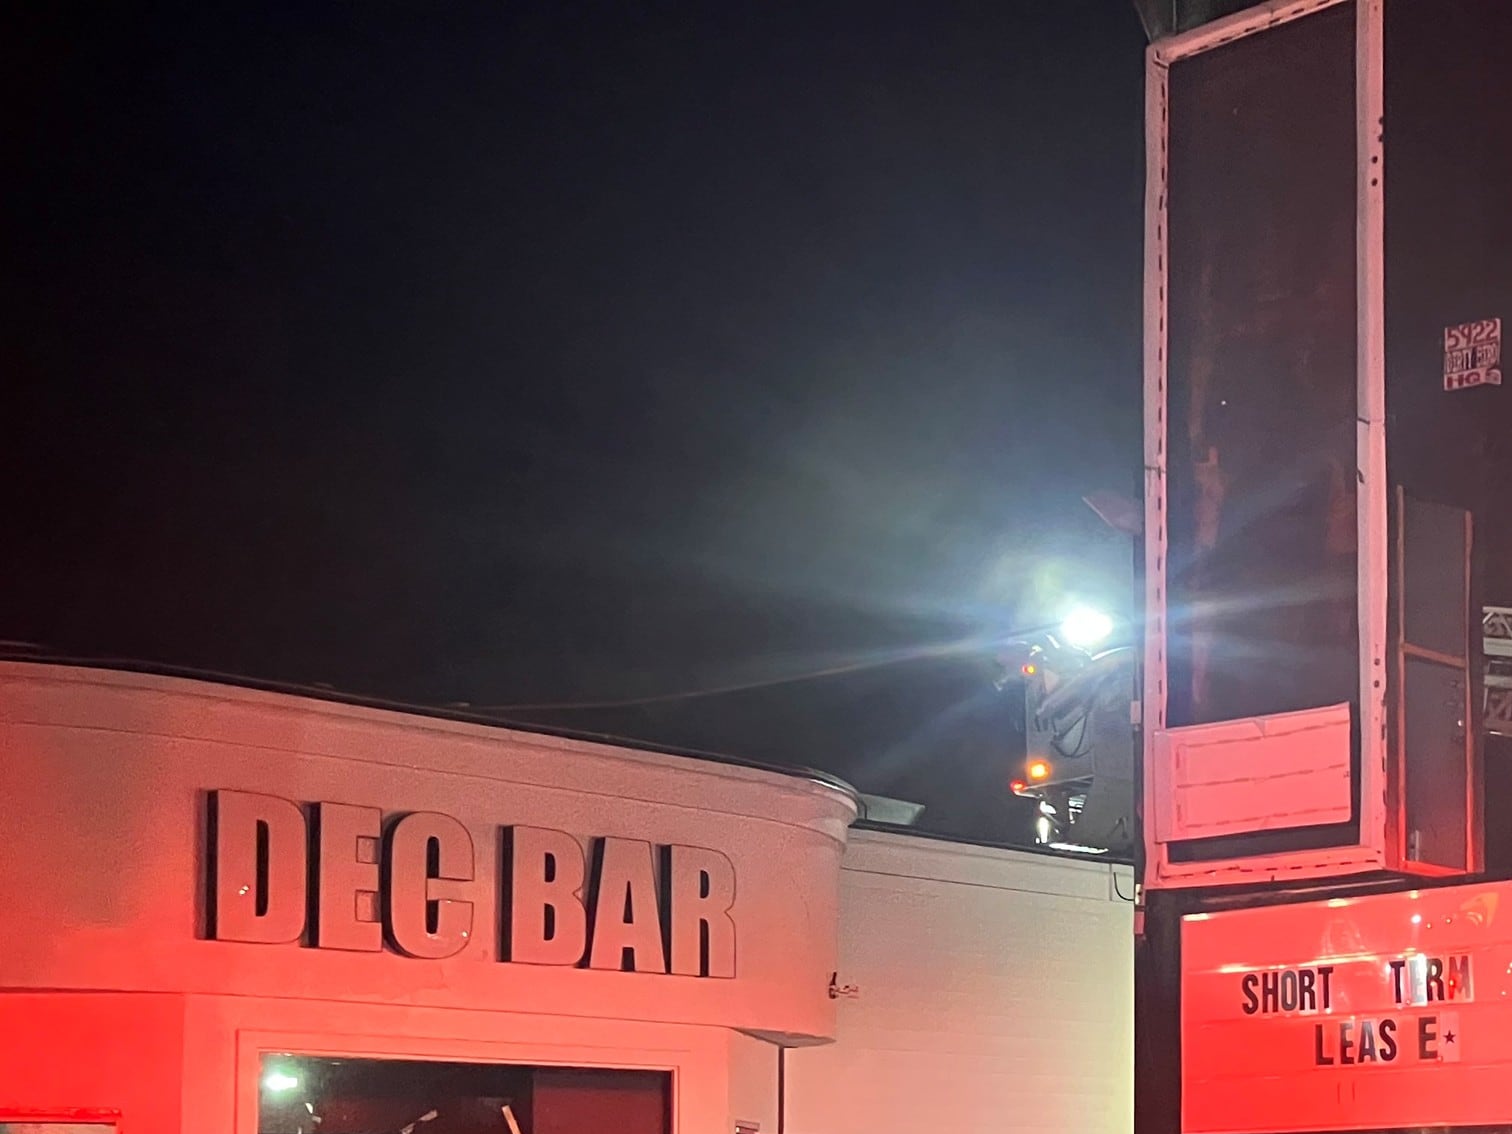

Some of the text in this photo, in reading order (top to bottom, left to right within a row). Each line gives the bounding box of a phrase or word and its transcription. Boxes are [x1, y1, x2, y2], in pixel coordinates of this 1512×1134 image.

[1447, 320, 1499, 348] 5922
[498, 824, 737, 979] BAR
[1241, 966, 1334, 1015] SHORT
